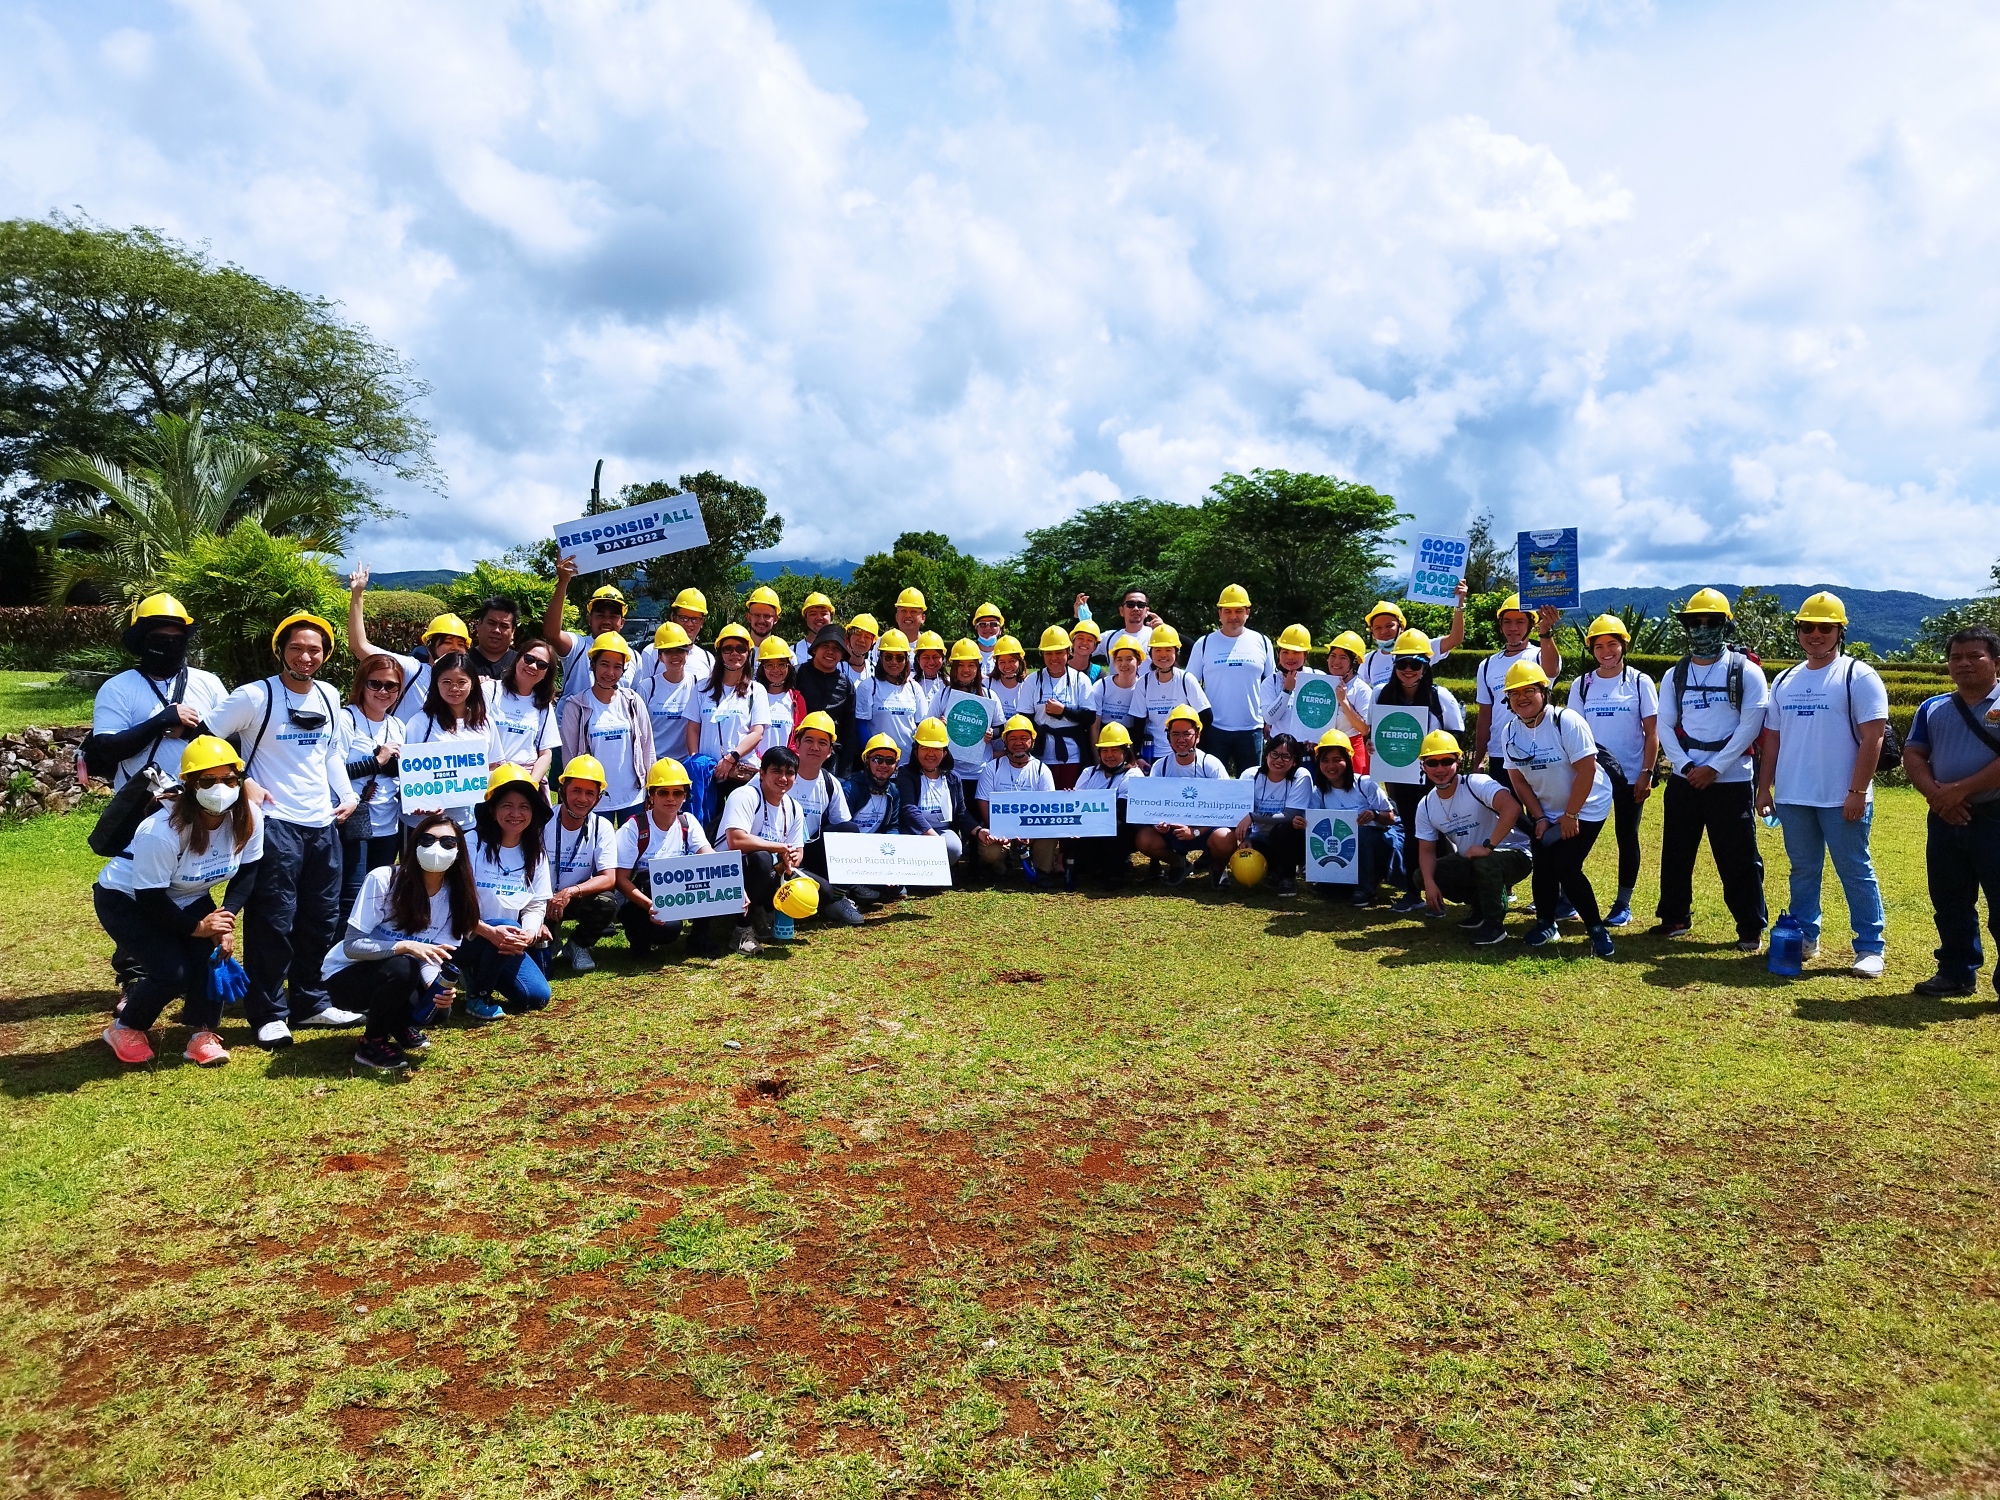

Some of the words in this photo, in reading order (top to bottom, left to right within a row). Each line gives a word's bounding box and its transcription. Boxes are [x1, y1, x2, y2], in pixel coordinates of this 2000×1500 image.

[559, 508, 694, 548] RESPONSIB'ALL
[603, 539, 628, 551] DAY
[630, 532, 658, 545] 2022
[1422, 538, 1465, 554] GOOD
[1420, 550, 1463, 567] TIMES
[1416, 570, 1459, 586] GOOD
[1413, 582, 1456, 598] PLACE
[1302, 695, 1332, 705] TERROIR
[953, 713, 983, 726] TERROIR
[1381, 731, 1418, 740] TERROIR
[401, 756, 442, 773] GOOD
[443, 752, 486, 769] TIMES
[403, 780, 443, 798] GOOD
[444, 776, 488, 793] PLACE
[991, 800, 1110, 814] RESPONSIB'ALL
[1128, 797, 1162, 806] Pernod
[1164, 799, 1195, 808] Ricard
[1197, 800, 1252, 811] Philippines
[1027, 817, 1048, 825] DAY
[1049, 816, 1075, 825] 2022
[828, 855, 862, 864] Pernod
[864, 856, 895, 865] Ricard
[897, 857, 947, 867] Philippines
[652, 868, 695, 885] GOOD
[696, 863, 740, 880] TIMES
[654, 892, 696, 909] GOOD
[696, 886, 742, 903] PLACE
